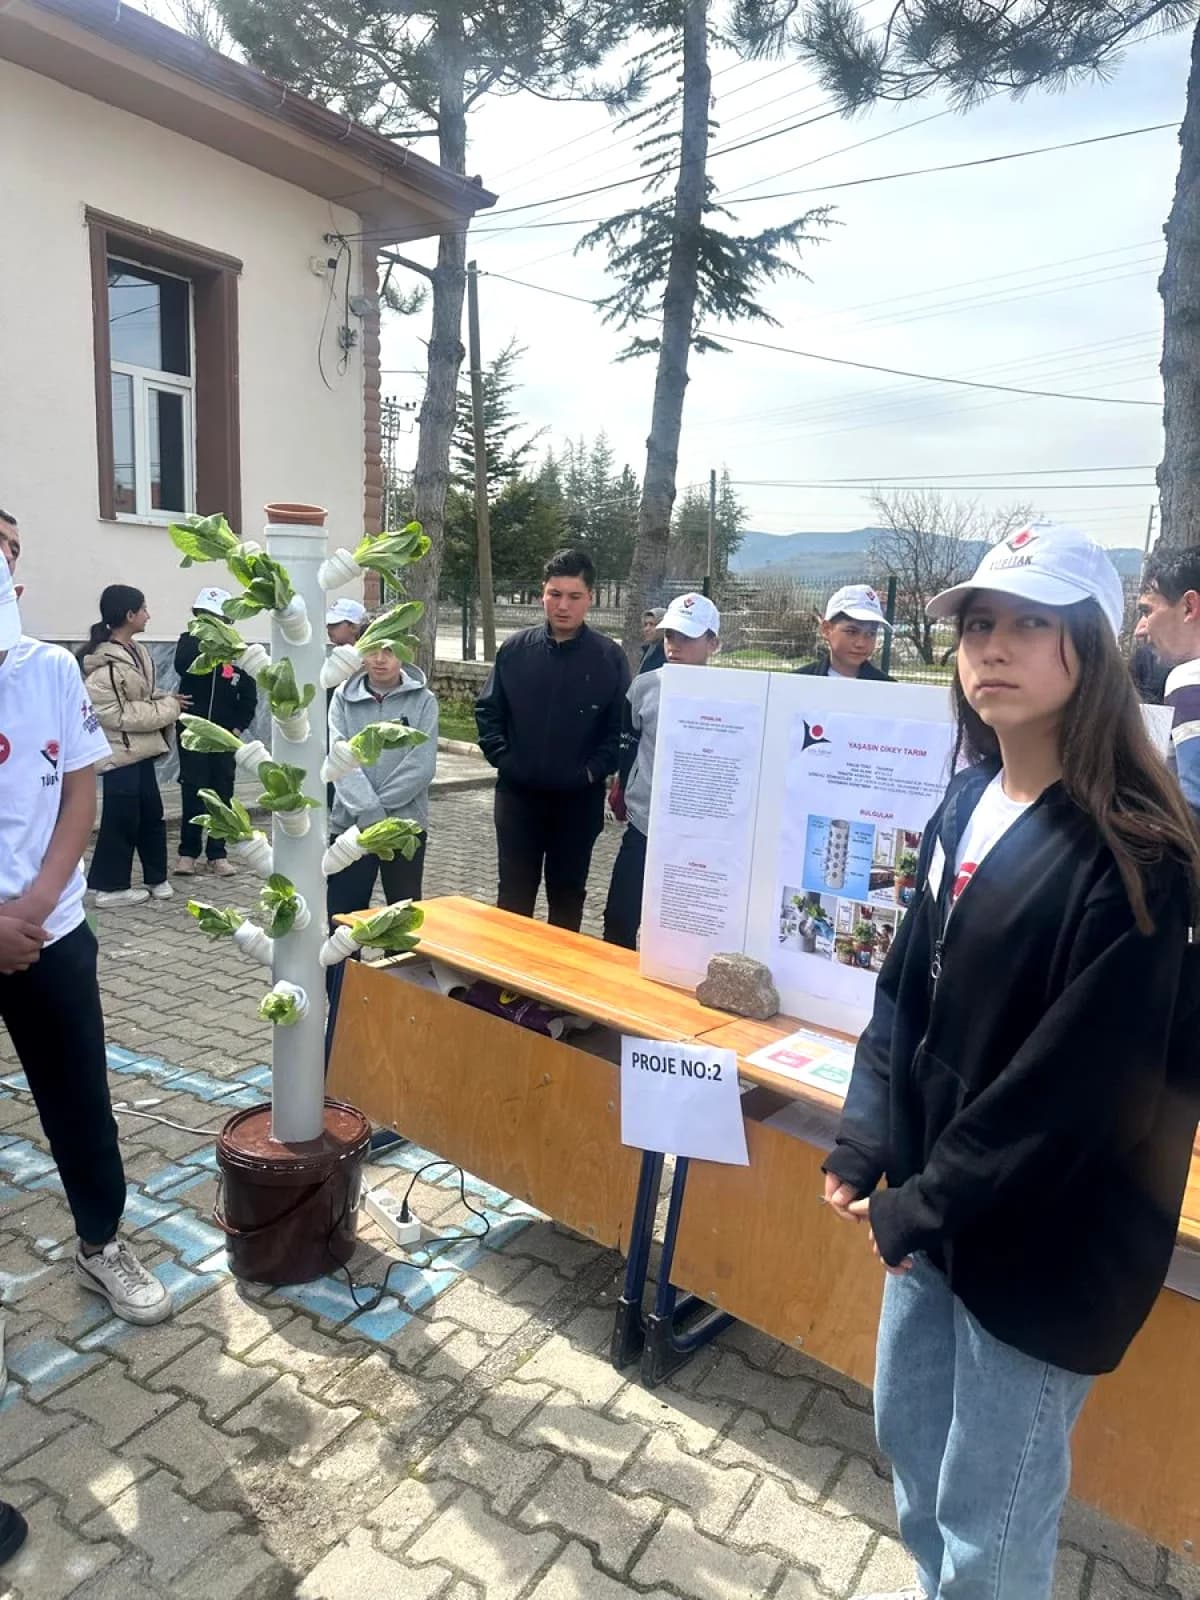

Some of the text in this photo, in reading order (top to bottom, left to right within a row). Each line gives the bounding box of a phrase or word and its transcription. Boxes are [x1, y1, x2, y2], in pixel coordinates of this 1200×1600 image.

[848, 742, 927, 757] YAŞASIN DİKEY TARIM
[860, 809, 894, 819] BULGULAR
[631, 1051, 722, 1081] PROJE NO:2
